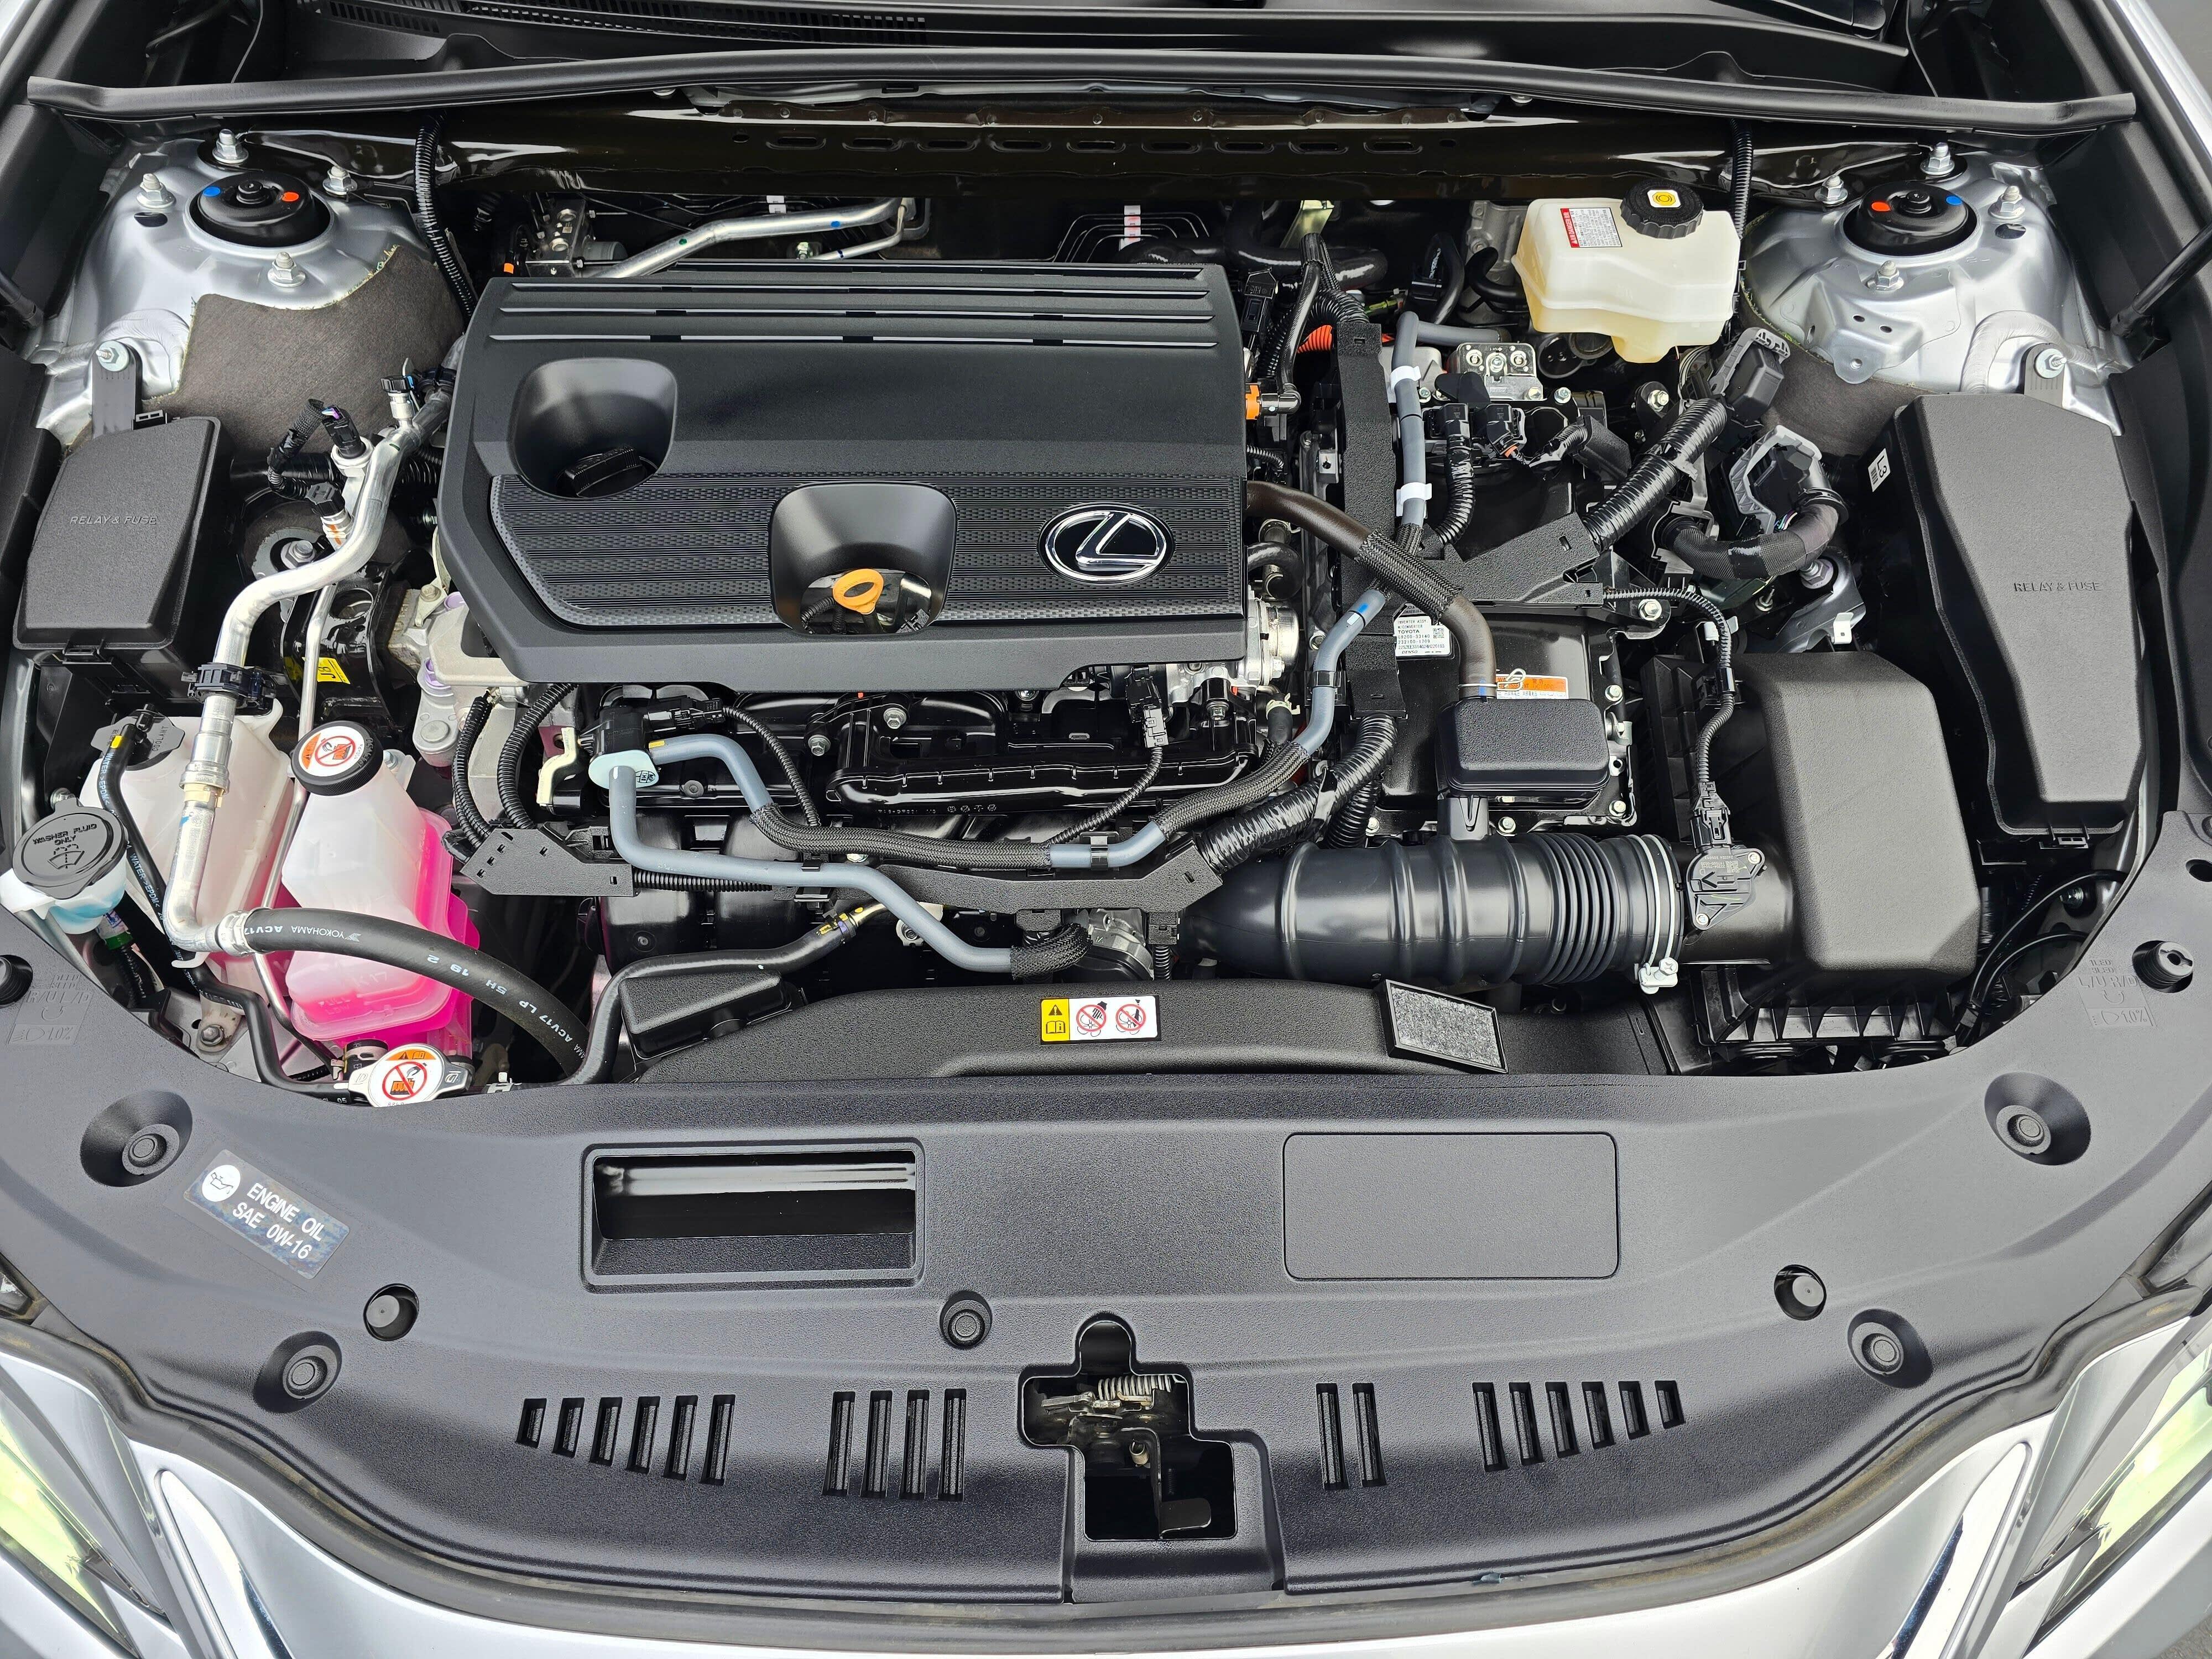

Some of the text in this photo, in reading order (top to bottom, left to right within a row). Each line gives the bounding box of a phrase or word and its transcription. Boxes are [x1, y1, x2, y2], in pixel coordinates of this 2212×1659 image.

[1877, 455, 1887, 478] L3
[70, 515, 158, 525] RELAY & FUSE
[2013, 582, 2102, 592] RELAY & FUSE
[152, 726, 169, 752] COOLANT
[100, 752, 114, 774] WATER
[33, 823, 97, 844] WASHER FLUID
[54, 835, 76, 846] ONLY
[130, 853, 146, 879] WATER
[244, 925, 345, 939] YOKOHAMA ACV17
[427, 954, 440, 964] 2
[450, 964, 469, 977] 19
[519, 1000, 537, 1014] LP
[539, 1014, 573, 1042] ACV17
[247, 1182, 325, 1241] ENGINE OIL
[232, 1202, 312, 1259] SAE 0W-16
